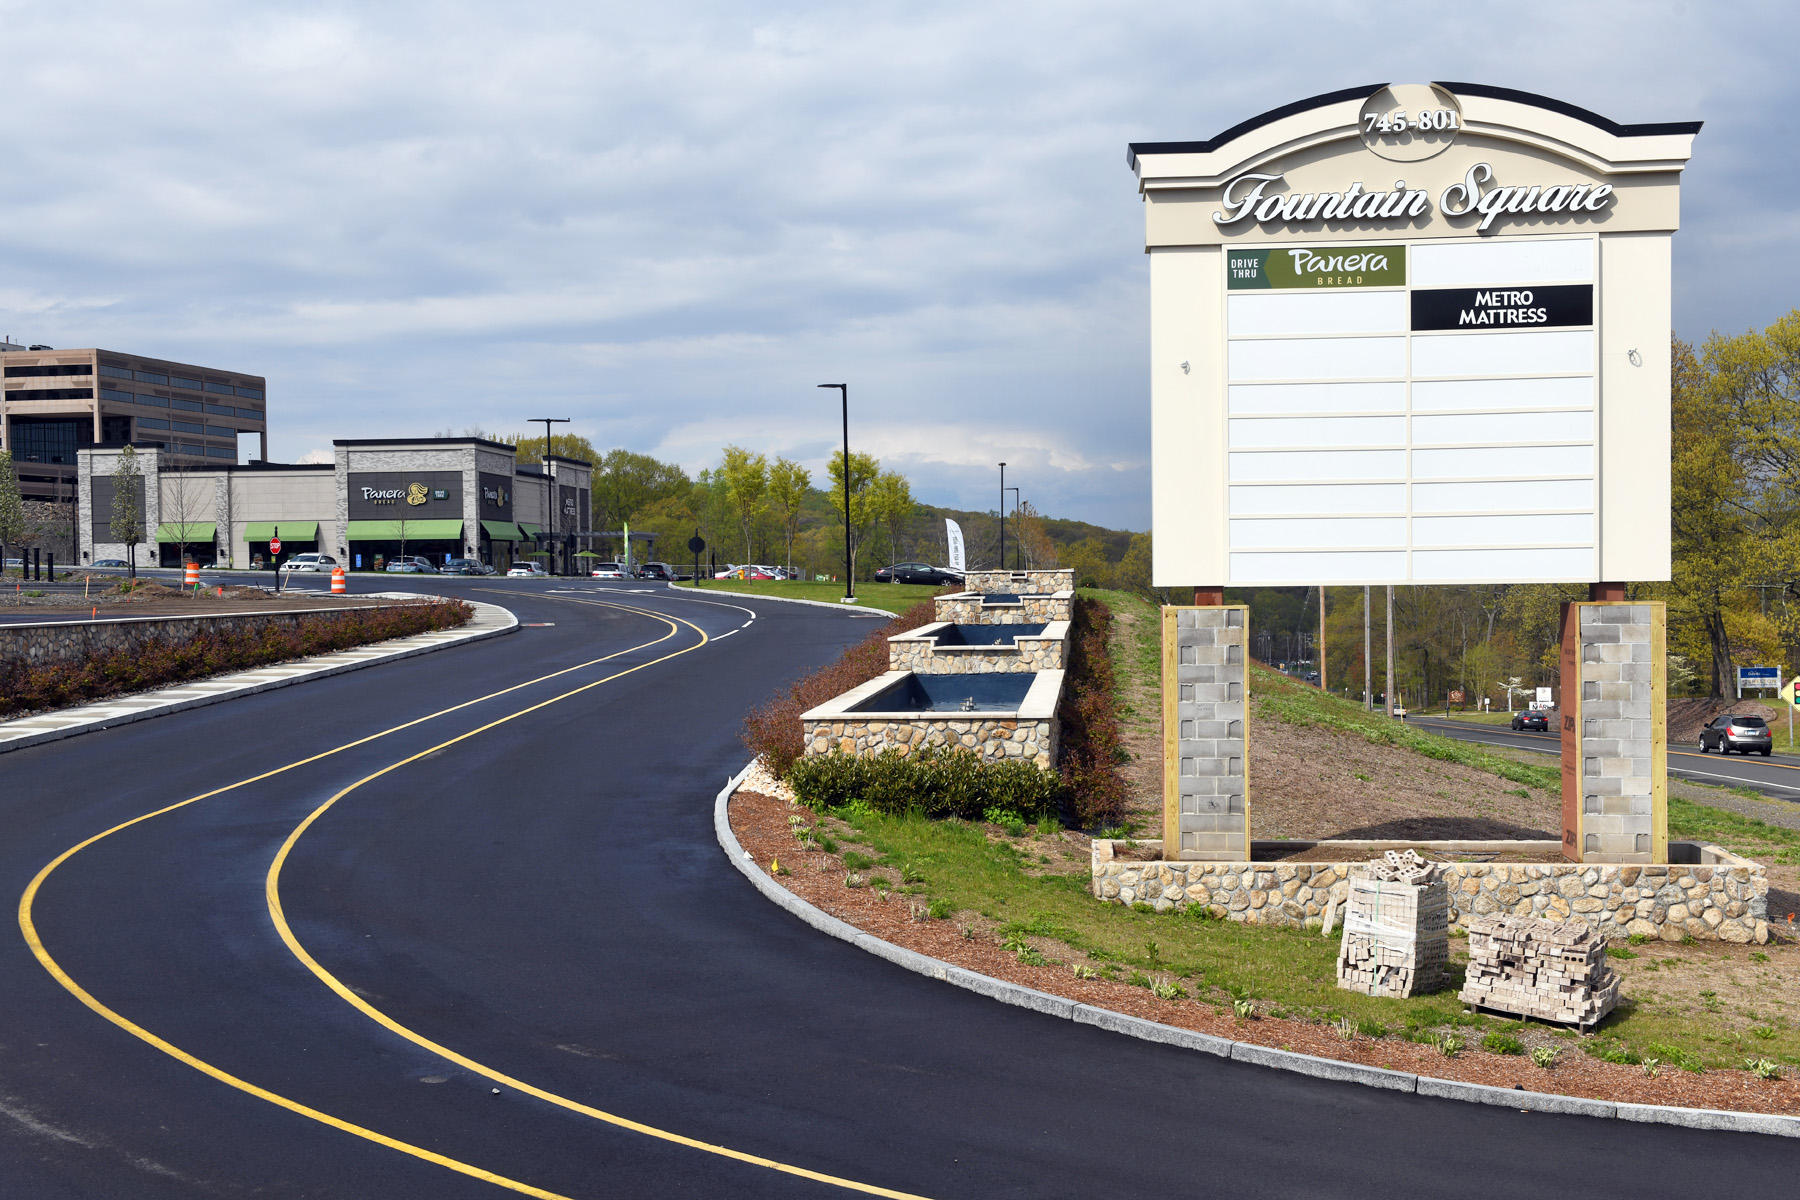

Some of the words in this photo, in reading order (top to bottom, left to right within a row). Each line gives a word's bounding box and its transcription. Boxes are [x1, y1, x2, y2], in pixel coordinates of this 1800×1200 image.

[1364, 110, 1459, 132] 745-801
[1212, 172, 1428, 225] Fountain
[1440, 162, 1614, 233] Square
[1231, 258, 1259, 268] DRIVE
[1288, 248, 1388, 276] Panera
[1232, 269, 1257, 279] THRU
[1317, 276, 1363, 286] BREAD
[1475, 290, 1533, 307] METRO
[1458, 308, 1547, 325] MATTRESS
[361, 486, 406, 500] Panera
